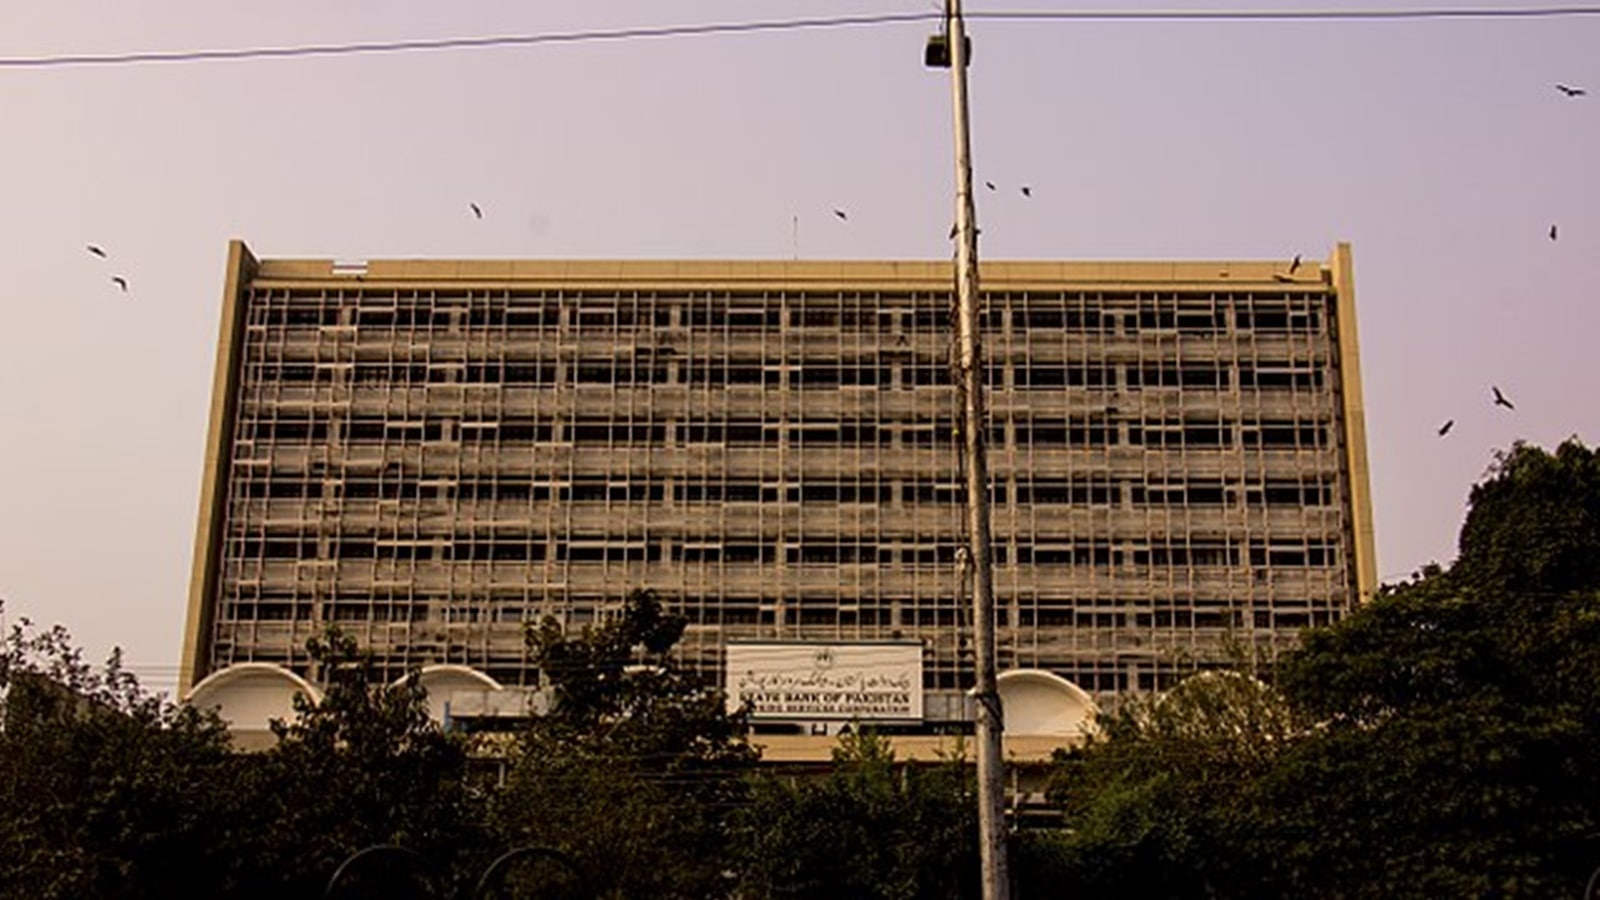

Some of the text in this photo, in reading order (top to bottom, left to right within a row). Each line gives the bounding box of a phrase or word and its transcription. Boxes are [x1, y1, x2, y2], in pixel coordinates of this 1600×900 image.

[739, 692, 910, 704] STATE BANK OF PAKISTAN
